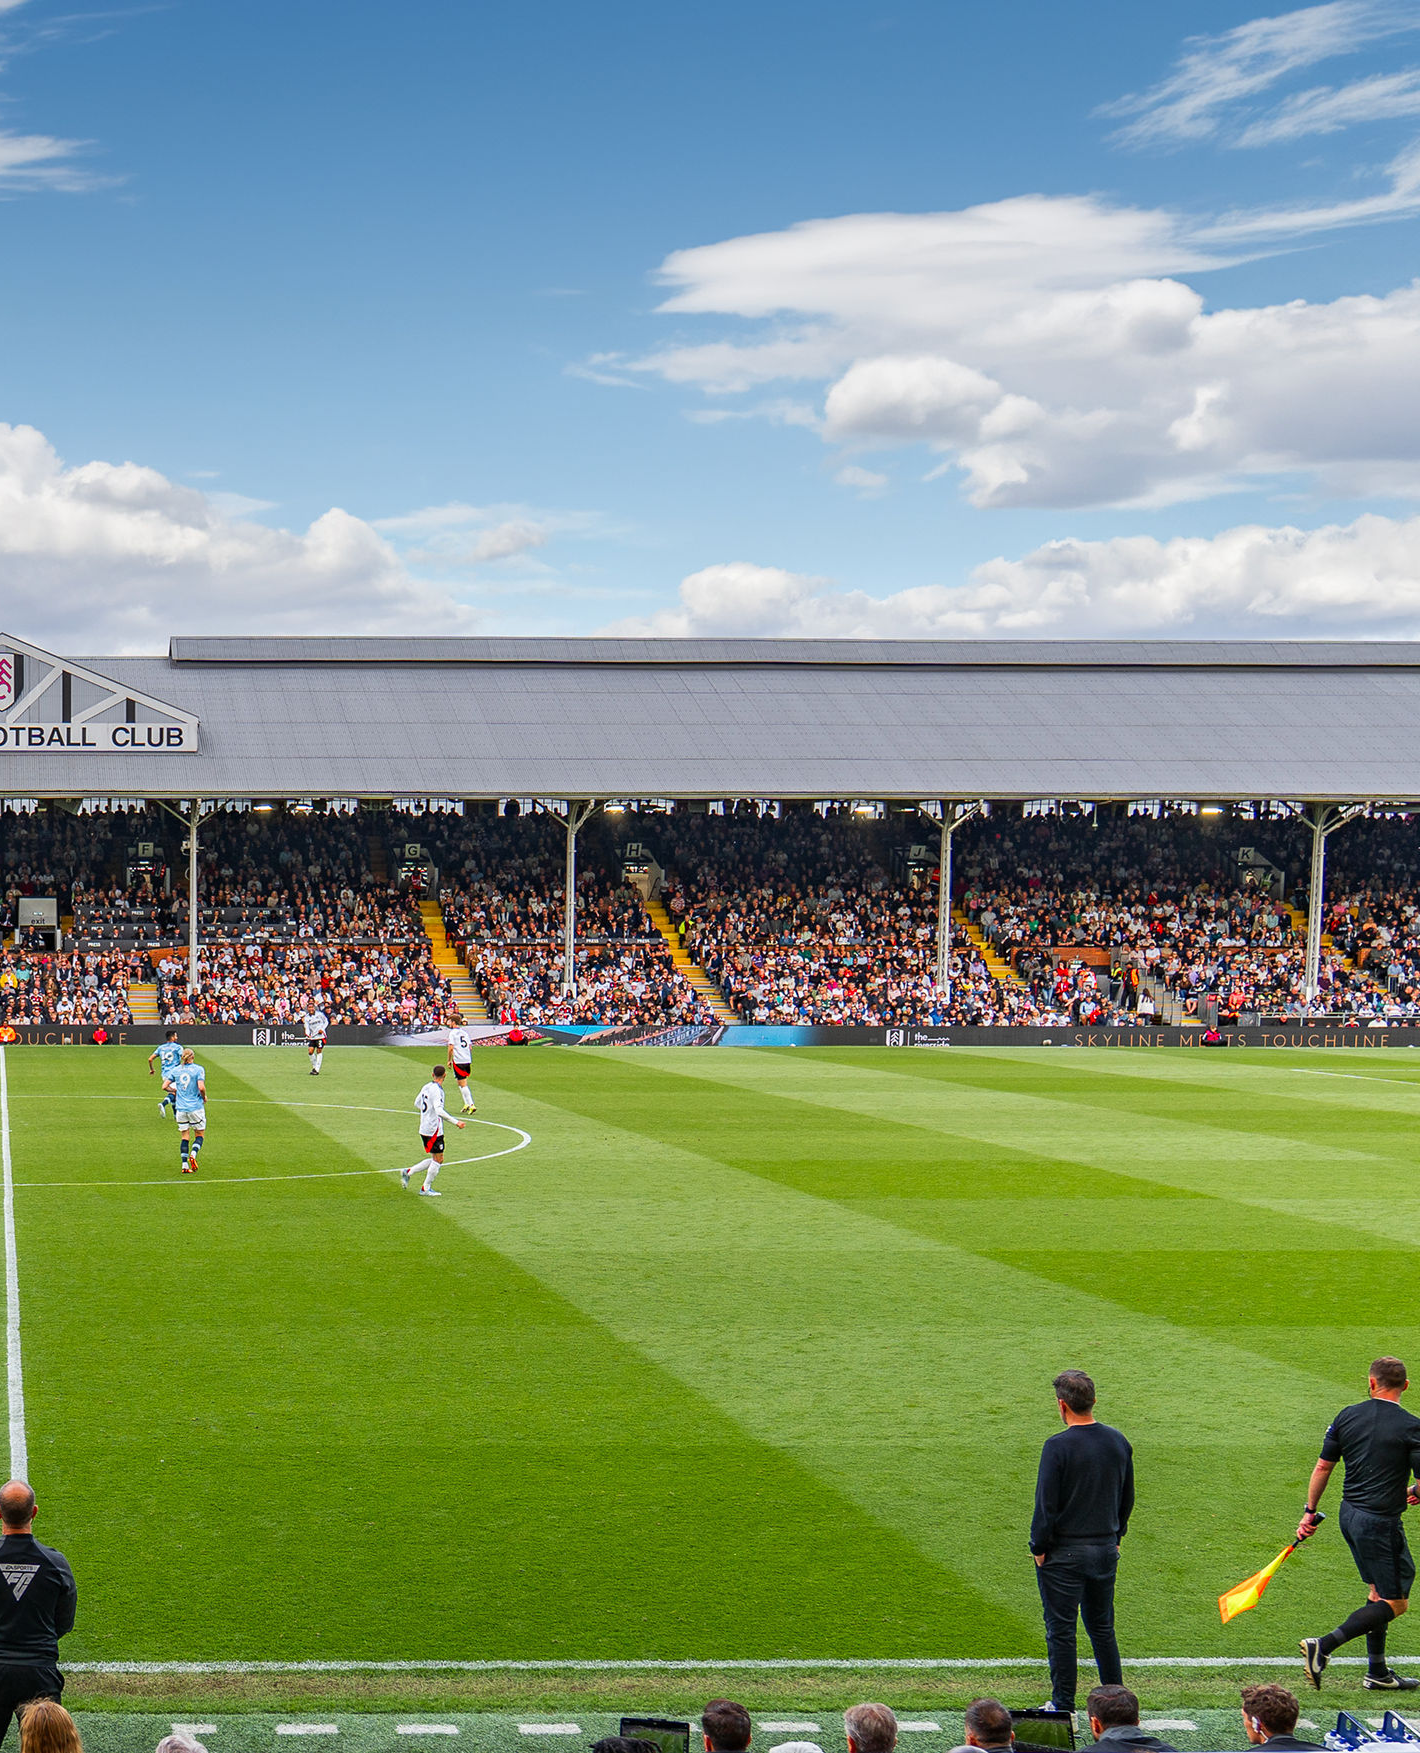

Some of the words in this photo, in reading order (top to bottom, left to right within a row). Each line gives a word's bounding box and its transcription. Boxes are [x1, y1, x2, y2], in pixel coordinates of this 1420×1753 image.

[112, 726, 184, 746] CLUB
[142, 845, 150, 855] F
[408, 845, 418, 856] G
[628, 844, 640, 855] H
[913, 847, 922, 857] J
[1240, 849, 1251, 859] K
[281, 1031, 295, 1040] the
[914, 1032, 928, 1041] the
[1075, 1034, 1164, 1047] SKYLINE
[1180, 1034, 1246, 1047] METS
[1261, 1034, 1389, 1047] TOUCHLINE
[460, 1036, 468, 1048] 5
[180, 1073, 190, 1090] 9
